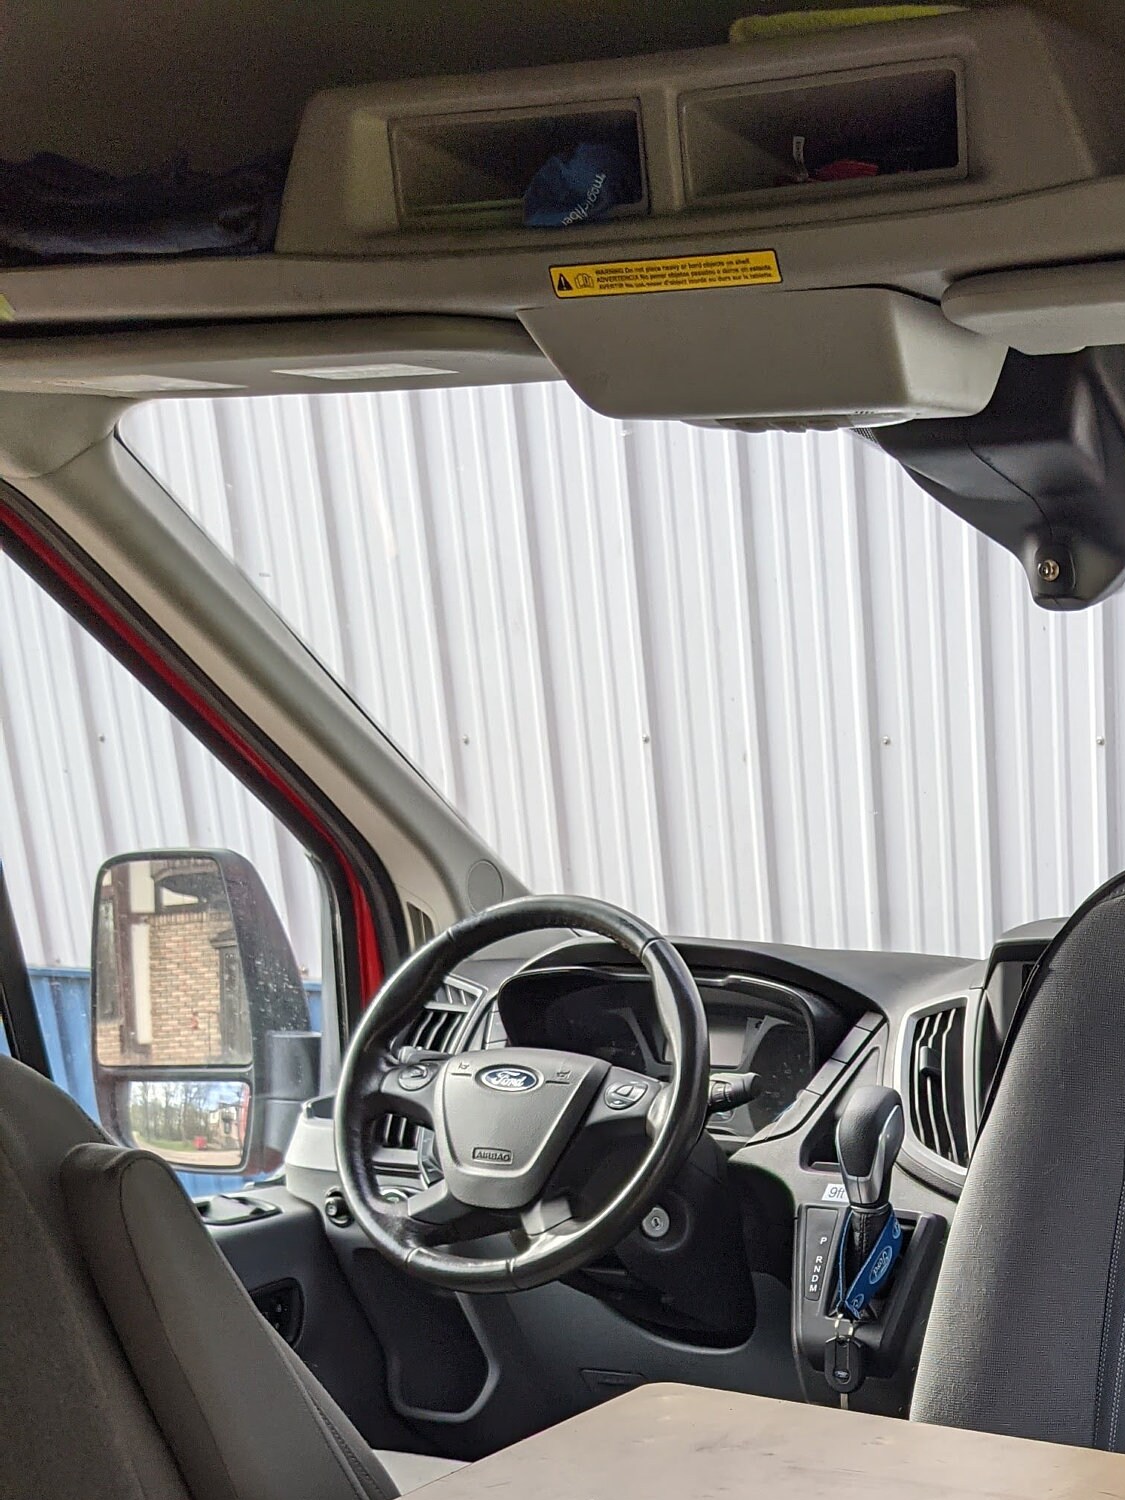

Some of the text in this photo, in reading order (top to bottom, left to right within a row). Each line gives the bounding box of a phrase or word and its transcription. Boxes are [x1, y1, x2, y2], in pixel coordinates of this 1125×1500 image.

[490, 1070, 527, 1087] Ford
[476, 1150, 511, 1162] AIRBAG
[820, 1236, 828, 1245] P
[815, 1255, 823, 1264] R
[813, 1265, 822, 1273] N
[811, 1274, 819, 1283] D
[809, 1284, 818, 1292] M
